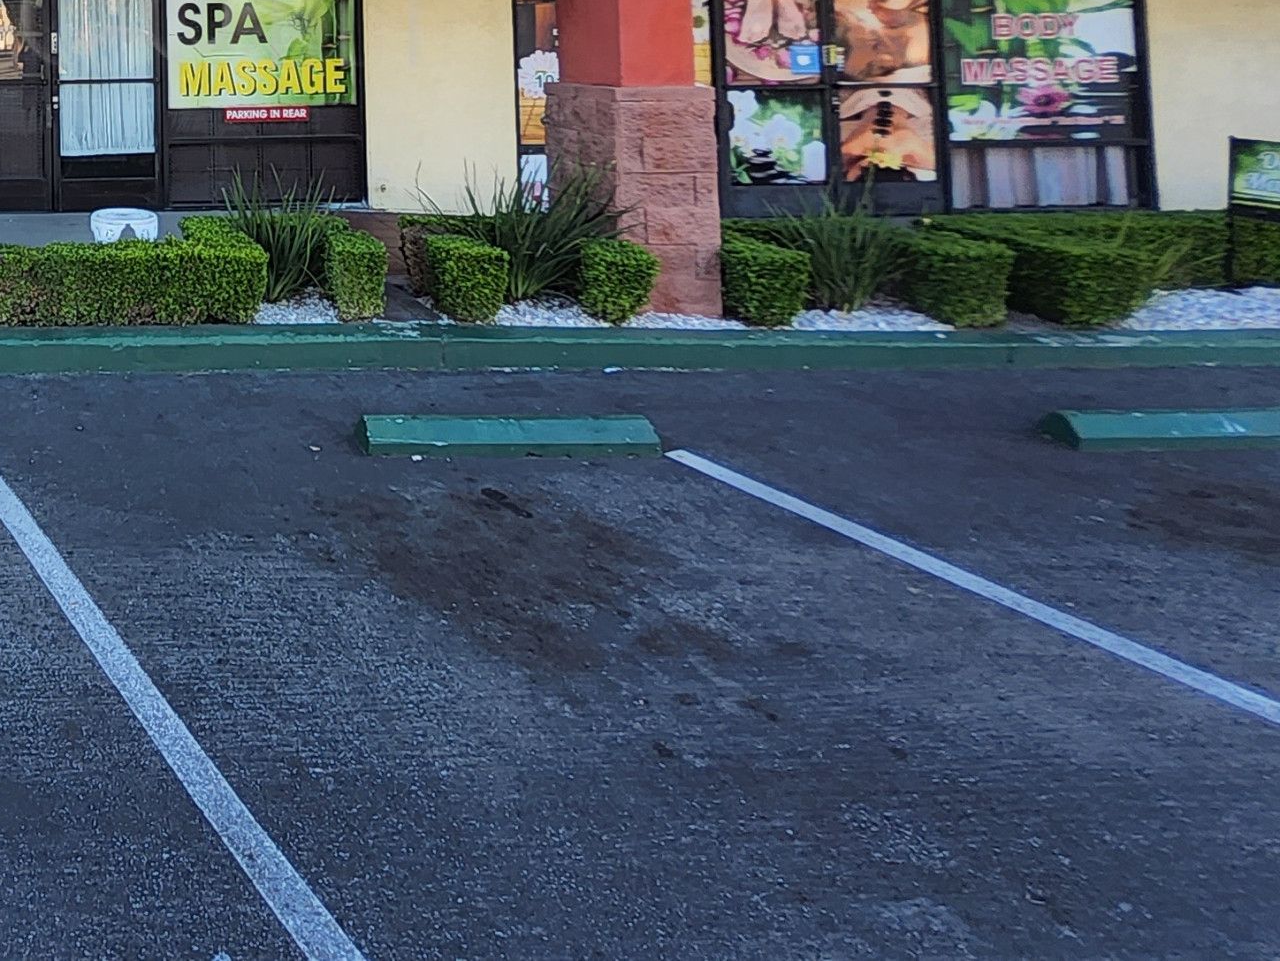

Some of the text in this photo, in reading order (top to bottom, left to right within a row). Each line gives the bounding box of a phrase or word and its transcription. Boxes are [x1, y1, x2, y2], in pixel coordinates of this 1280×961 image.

[177, 2, 269, 46] SPA
[992, 13, 1080, 40] BODY
[179, 58, 348, 97] MASSAGE
[961, 56, 1120, 85] MASSAGE
[226, 108, 307, 120] PARKING IN REAR
